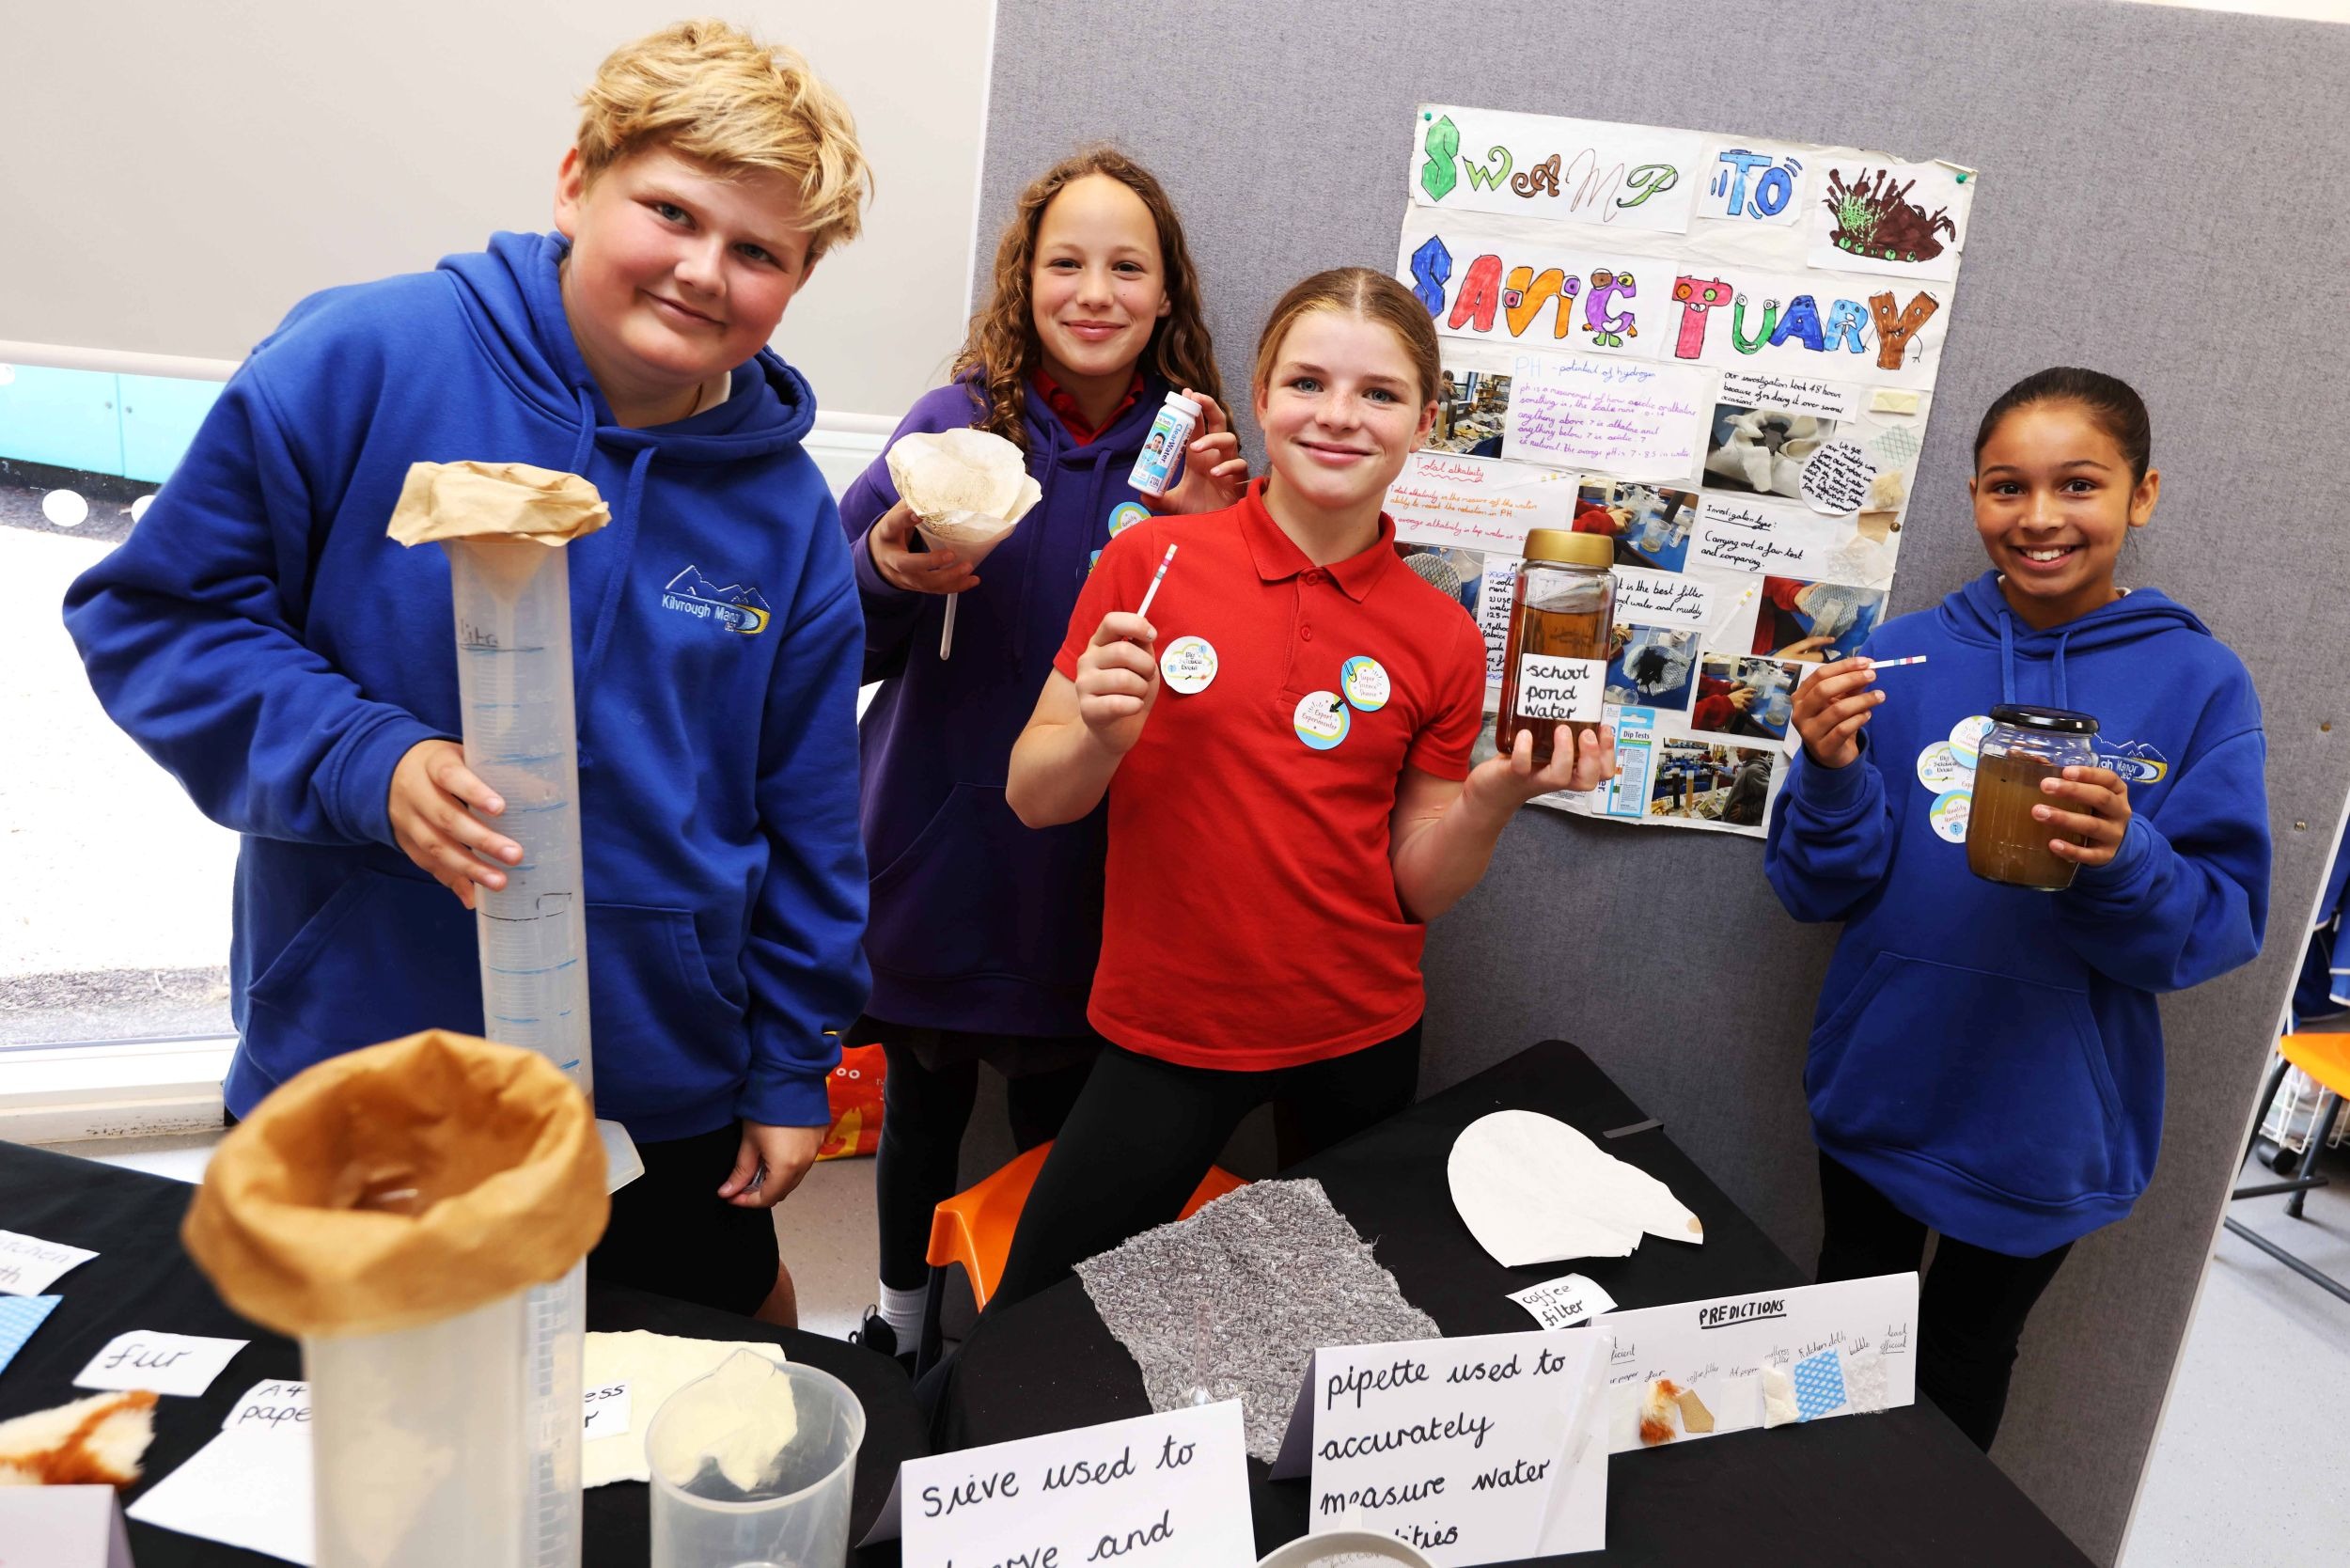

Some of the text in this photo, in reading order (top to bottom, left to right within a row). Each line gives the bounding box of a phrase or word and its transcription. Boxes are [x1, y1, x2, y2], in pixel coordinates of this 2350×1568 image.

[1719, 150, 1793, 217] TO
[1514, 356, 1655, 384] PH potential of hydrogen
[1606, 394, 1625, 403] how
[1723, 382, 1751, 397] because
[1771, 390, 1791, 408] doing
[1792, 393, 1801, 405] it
[1741, 376, 1788, 389] investigation
[1790, 378, 1807, 392] took
[1809, 384, 1823, 395] 48
[1822, 384, 1842, 399] hours
[1518, 394, 1557, 412] something
[1574, 399, 1588, 410] the
[1517, 407, 1556, 430] anything
[1559, 411, 1585, 426] above
[1606, 419, 1639, 433] alkaline
[1639, 426, 1660, 435] and
[1517, 423, 1557, 441] anything
[1558, 426, 1583, 440] below
[1417, 457, 1484, 482] Total alkalinity
[1409, 488, 1438, 505] alkalinity
[1706, 505, 1755, 522] Investigation
[1425, 517, 1462, 537] alkalinity
[1471, 524, 1483, 538] tap
[1700, 544, 1718, 557] and
[1705, 530, 1740, 552] Carrying
[1740, 539, 1757, 550] out
[1783, 547, 1805, 560] test
[1625, 583, 1634, 591] is
[1636, 579, 1649, 594] the
[1653, 580, 1674, 596] best
[1673, 584, 1704, 604] filter
[662, 594, 712, 619] Kilvrough
[1630, 598, 1702, 619] water and muddy
[1526, 663, 1590, 681] school
[1526, 684, 1578, 702] pond
[1301, 712, 1338, 730] Experimenter
[1314, 709, 1333, 721] Expert
[1525, 703, 1576, 719] water
[1623, 730, 1651, 740] Dip Tests
[2116, 760, 2138, 774] Manor
[1522, 1285, 1573, 1307] coffee
[1542, 1299, 1584, 1326] filter
[1699, 1299, 1785, 1325] PREDICTIONS
[105, 1342, 193, 1370] fur
[1848, 1336, 1871, 1356] bubble
[1327, 1348, 1566, 1410] pipette used to
[1644, 1369, 1666, 1383] fur
[258, 1384, 307, 1398] A4
[239, 1404, 313, 1429] pape
[1318, 1411, 1495, 1461] accurately
[922, 1434, 1197, 1518] Sieve used to
[1471, 1458, 1551, 1491] water
[1087, 1509, 1175, 1562] and
